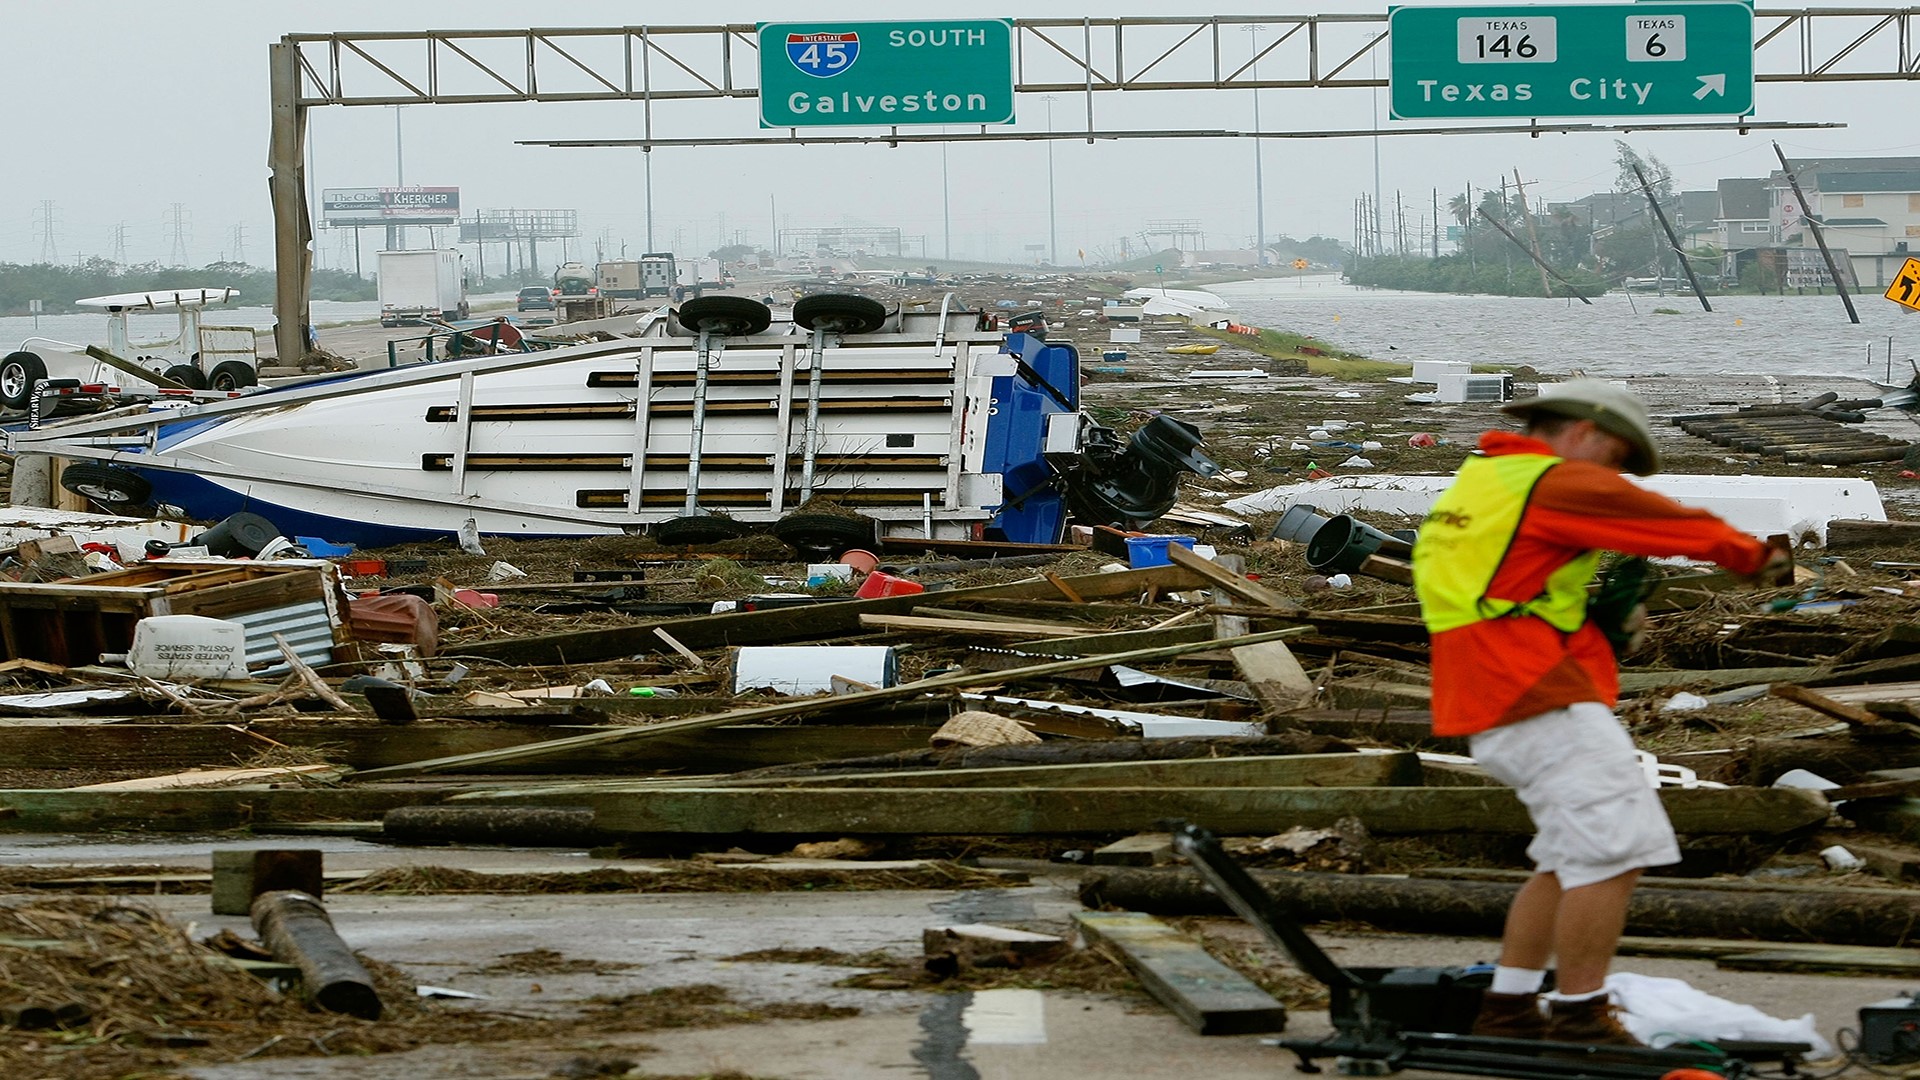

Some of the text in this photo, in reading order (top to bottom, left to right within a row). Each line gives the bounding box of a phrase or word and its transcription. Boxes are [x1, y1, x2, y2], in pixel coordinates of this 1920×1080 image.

[1486, 21, 1527, 31] TEXAS
[1637, 20, 1675, 30] TEXAS
[889, 29, 986, 47] SOUTH
[1475, 33, 1538, 59] 146
[1645, 32, 1667, 57] 6
[798, 43, 848, 69] 45
[1417, 77, 1654, 105] Texas City
[788, 90, 986, 114] Galveston
[332, 193, 352, 202] The
[153, 644, 235, 653] POSTAL SERVICE
[158, 652, 230, 660] UNITED STATES
